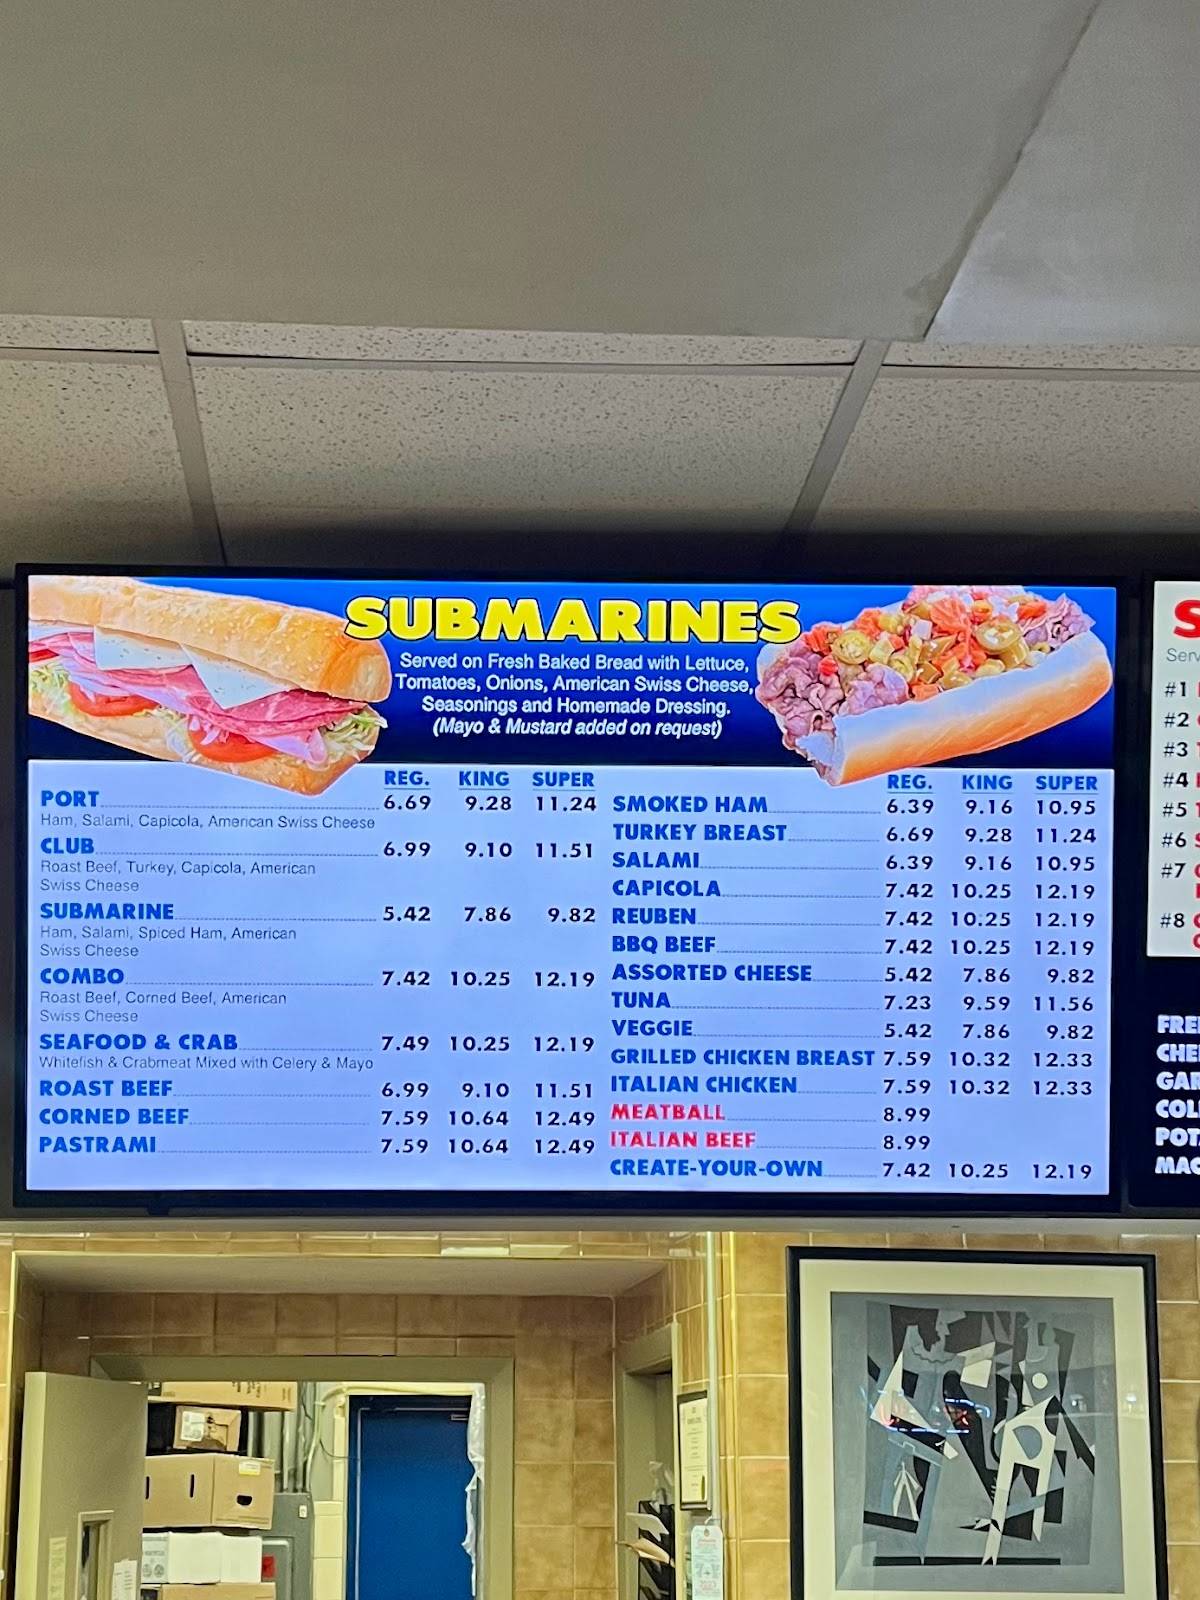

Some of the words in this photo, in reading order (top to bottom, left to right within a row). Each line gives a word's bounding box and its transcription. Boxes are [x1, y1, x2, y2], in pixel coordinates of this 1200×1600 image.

[344, 596, 801, 644] SUBMARINES
[400, 652, 457, 669] Served
[462, 656, 482, 669] on
[488, 653, 534, 669] Fresh
[539, 654, 590, 669] Baked
[596, 654, 643, 670] Bread
[647, 655, 679, 670] with
[686, 655, 748, 673] Lettuce,
[395, 673, 481, 692] Tomatoes,
[486, 674, 548, 693] Onions,
[552, 675, 630, 691] American
[634, 676, 682, 692] Swiss
[686, 676, 756, 695] Cheese,
[1165, 681, 1187, 697] #1
[422, 696, 517, 718] Seasonings
[522, 697, 552, 713] and
[557, 697, 650, 714] Homemade
[656, 698, 730, 718] Dressing.
[433, 717, 484, 737] (Mayo
[488, 718, 500, 734] &
[506, 718, 572, 735] Mustard
[575, 719, 628, 735] added
[630, 722, 651, 735] on
[655, 716, 724, 739] request)
[1164, 712, 1189, 728] #2
[1163, 742, 1188, 757] #3
[385, 770, 429, 785] REG.
[459, 771, 509, 786] KING
[533, 772, 594, 786] SUPER
[888, 775, 932, 789] REG.
[963, 775, 1012, 790] KING
[1036, 776, 1097, 790] SUPER
[1163, 772, 1188, 787] #4
[41, 791, 99, 807] PORT
[384, 796, 431, 810] 6.69
[465, 796, 511, 811] 9.28
[537, 796, 596, 811] 11.24
[613, 796, 708, 812] SMOKED
[716, 796, 769, 813] HAM
[887, 799, 933, 814] 6.39
[966, 800, 1012, 814] 9.16
[1037, 800, 1095, 815] 10.95
[1162, 802, 1187, 817] #5
[41, 814, 76, 827] Ham,
[82, 814, 133, 827] Salami,
[139, 814, 203, 829] Capicola,
[208, 815, 273, 827] American
[278, 816, 317, 828] Swiss
[322, 816, 375, 829] Cheese
[613, 824, 696, 840] TURKEY
[704, 825, 787, 841] BREAST
[887, 827, 933, 842] 6.69
[965, 828, 1012, 842] 9.28
[1037, 828, 1096, 843] 11.24
[1161, 832, 1187, 848] #6
[41, 838, 94, 854] CLUB
[384, 842, 430, 857] 6.99
[465, 843, 512, 857] 9.10
[536, 843, 591, 858] 11.51
[41, 860, 81, 872] Roast
[86, 860, 120, 874] Beef,
[126, 860, 176, 876] Turkey,
[182, 861, 245, 876] Capicola,
[250, 862, 315, 874] American
[613, 852, 700, 868] SALAMI
[1161, 863, 1186, 879] #7
[40, 879, 80, 891] Swiss
[86, 879, 139, 891] Cheese
[612, 880, 720, 896] CAPICOLA
[886, 883, 933, 898] 7.42
[952, 884, 1011, 898] 10.25
[1036, 884, 1094, 899] 12.19
[41, 903, 173, 919] SUBMARINE
[383, 907, 430, 921] 5.42
[465, 908, 511, 922] 7.86
[548, 908, 595, 923] 9.82
[613, 908, 696, 924] REUBEN
[1160, 913, 1185, 928] #8
[41, 926, 76, 939] Ham,
[82, 926, 132, 940] Salami,
[139, 926, 185, 941] Spiced
[191, 927, 226, 941] Ham,
[231, 927, 296, 940] American
[40, 944, 80, 956] Swiss
[85, 944, 139, 957] Cheese
[612, 936, 658, 954] BBQ
[666, 936, 718, 952] BEEF
[40, 968, 124, 984] COMBO
[382, 971, 430, 986] 7.42
[451, 971, 510, 986] 10.25
[535, 972, 594, 987] 12.19
[612, 964, 727, 980] ASSORTED
[735, 965, 813, 981] CHEESE
[885, 967, 932, 982] 5.42
[961, 968, 1010, 984] 7.86
[1048, 969, 1094, 983] 9.82
[41, 991, 80, 1003] Roast
[86, 991, 120, 1005] Beef,
[126, 991, 176, 1004] Corned
[182, 991, 216, 1006] Beef,
[222, 992, 286, 1004] American
[612, 992, 671, 1008] TUNA
[884, 995, 931, 1010] 7.23
[964, 996, 1010, 1010] 9.59
[1035, 996, 1093, 1011] 11.56
[40, 1009, 80, 1022] Swiss
[85, 1009, 138, 1022] Cheese
[612, 1020, 693, 1036] VEGGIE
[40, 1034, 146, 1050] SEAFOOD
[155, 1034, 170, 1050] &
[179, 1034, 237, 1050] CRAB
[39, 1056, 102, 1068] Whitefish
[108, 1056, 117, 1068] &
[123, 1056, 190, 1068] Crabmeat
[196, 1056, 236, 1069] Mixed
[241, 1057, 268, 1068] with
[273, 1056, 317, 1072] Celery
[322, 1057, 331, 1069] &
[337, 1057, 373, 1072] Mayo
[611, 1048, 696, 1064] GRILLED
[704, 1049, 789, 1065] CHICKEN
[797, 1050, 875, 1065] BREAST
[884, 1051, 931, 1066] 7.59
[950, 1052, 1010, 1067] 10.32
[1034, 1053, 1092, 1067] 12.33
[40, 1080, 114, 1096] ROAST
[122, 1080, 172, 1096] BEEF
[382, 1082, 429, 1097] 6.99
[462, 1083, 509, 1098] 9.10
[536, 1083, 591, 1098] 11.51
[612, 1076, 698, 1092] ITALIAN
[706, 1076, 800, 1093] CHICKEN
[39, 1109, 130, 1124] CORNED
[138, 1109, 189, 1124] BEEF
[382, 1111, 428, 1125] 7.59
[449, 1111, 508, 1125] 10.64
[536, 1112, 595, 1126] 12.49
[612, 1104, 725, 1120] MEATBALL
[884, 1107, 930, 1122] 8.99
[40, 1137, 155, 1152] PASTRAMI
[611, 1132, 697, 1147] ITALIAN
[707, 1132, 755, 1147] BEEF
[884, 1135, 930, 1150] 8.99
[1155, 1127, 1200, 1147] POT
[610, 1159, 822, 1176] CREATE-YOUR-OWN
